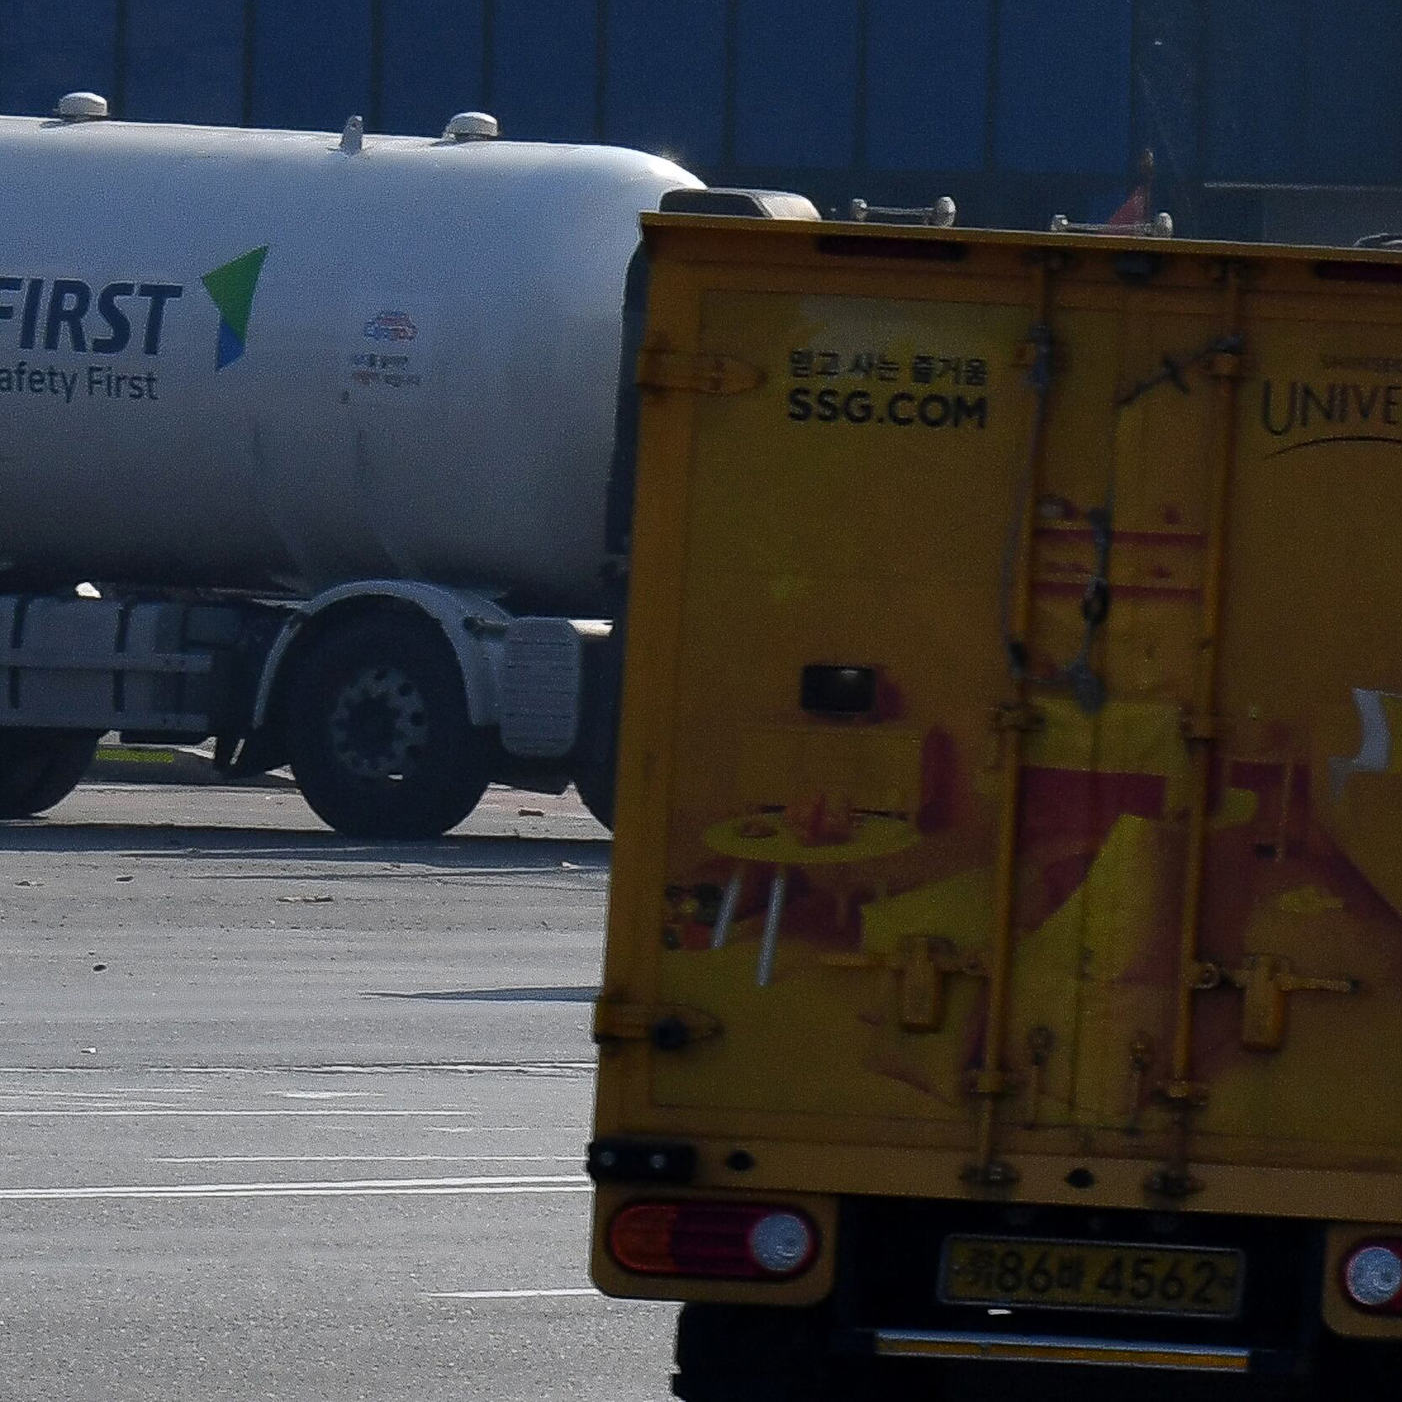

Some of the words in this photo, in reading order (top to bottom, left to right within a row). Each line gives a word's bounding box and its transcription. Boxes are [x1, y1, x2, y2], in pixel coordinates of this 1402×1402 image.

[88, 365, 159, 401] First
[788, 386, 988, 430] SSG.COM
[1096, 1255, 1219, 1304] 4562
